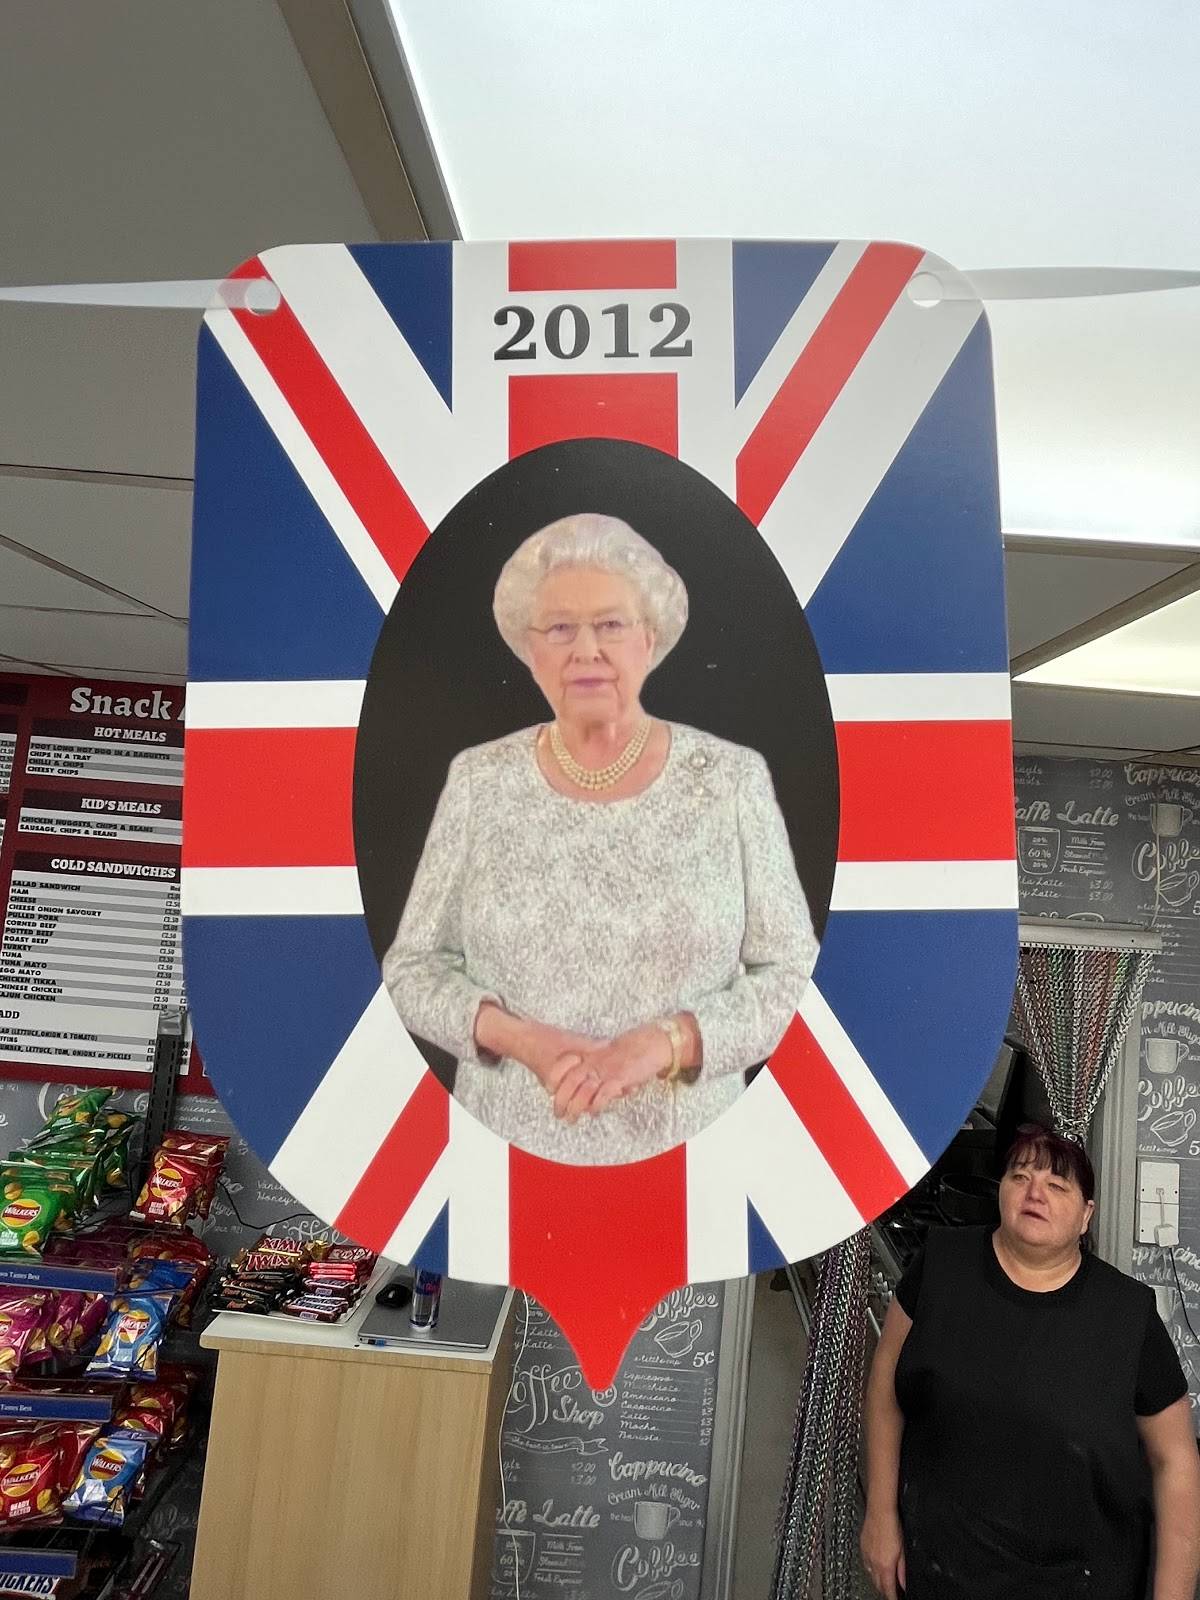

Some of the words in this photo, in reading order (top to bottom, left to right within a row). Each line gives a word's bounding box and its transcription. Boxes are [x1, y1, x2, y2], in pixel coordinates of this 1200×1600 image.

[494, 302, 693, 360] 2012
[70, 687, 172, 720] Snack
[94, 727, 121, 738] HOT
[123, 729, 167, 742] MEALS
[81, 798, 116, 812] KID'S
[117, 801, 162, 814] MEALS
[1056, 800, 1119, 826] Latte
[21, 816, 53, 825] CHICKEN
[95, 822, 118, 830] CHIPS
[19, 824, 57, 833] SAUSAGE,
[93, 830, 117, 838] BEANS
[1027, 848, 1052, 858] 60%
[51, 858, 86, 871] COLD
[87, 860, 176, 879] SANDWICHES
[39, 882, 81, 891] SANDWICH
[1036, 877, 1064, 887] Latte
[1031, 888, 1060, 898] Latte
[38, 906, 64, 914] ONION
[66, 908, 101, 917] SAVOURY
[1192, 900, 1200, 915] 5
[38, 913, 59, 922] PORK
[3, 943, 32, 951] TURKEY
[0, 959, 21, 967] TUNA
[23, 961, 47, 969] MAYO
[23, 993, 56, 1002] CHICKEN
[31, 986, 63, 994] CHICKEN
[1188, 1140, 1200, 1156] 5
[4, 1206, 38, 1217] WALKERS
[260, 1237, 303, 1255] TWIX
[246, 1253, 290, 1271] TWIX
[693, 1350, 715, 1368] 5¢
[508, 1364, 582, 1433] offee
[622, 1391, 678, 1403] Americano
[552, 1395, 605, 1431] Shop
[620, 1420, 659, 1431] Mocha
[92, 1457, 123, 1472] WALKERS
[608, 1451, 708, 1488] Cappucino
[3, 1471, 40, 1486] WALKERS
[608, 1487, 642, 1505] Cream
[9, 1506, 31, 1518] SALTED
[10, 1500, 30, 1510] READY
[532, 1499, 601, 1528] Latte
[611, 1541, 700, 1592] Coffee
